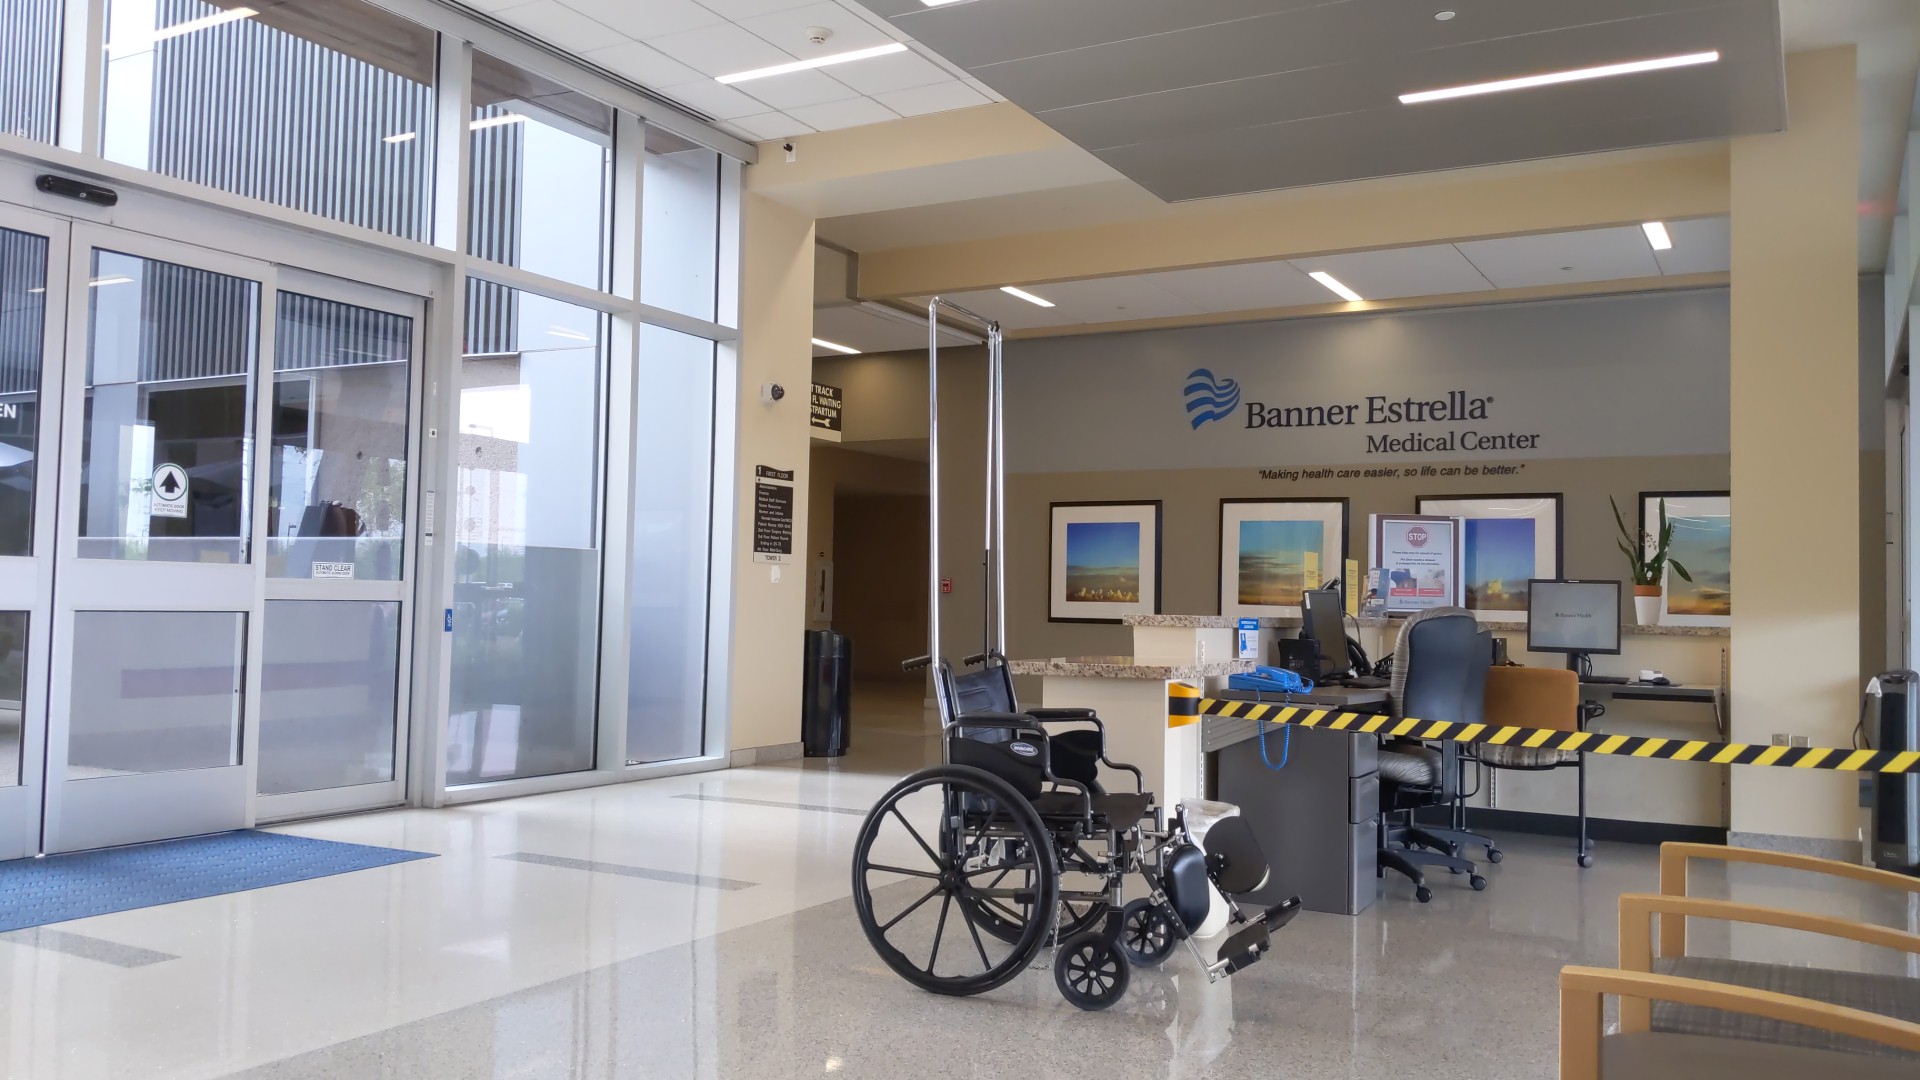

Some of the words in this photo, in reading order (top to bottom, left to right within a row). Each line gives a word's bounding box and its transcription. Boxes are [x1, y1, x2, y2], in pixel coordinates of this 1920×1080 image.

[815, 385, 833, 397] TRACK
[819, 397, 841, 409] WAITING
[1245, 402, 1359, 429] Banner
[1366, 432, 1455, 453] Medical
[1460, 431, 1540, 450] Center
[758, 466, 762, 475] 1
[1302, 468, 1334, 479] health
[1337, 469, 1361, 478] care
[1364, 467, 1399, 478] easier,
[1404, 469, 1417, 477] so
[1420, 466, 1437, 476] life
[1440, 467, 1461, 476] can
[1464, 465, 1479, 475] be
[1408, 533, 1426, 541] STOP
